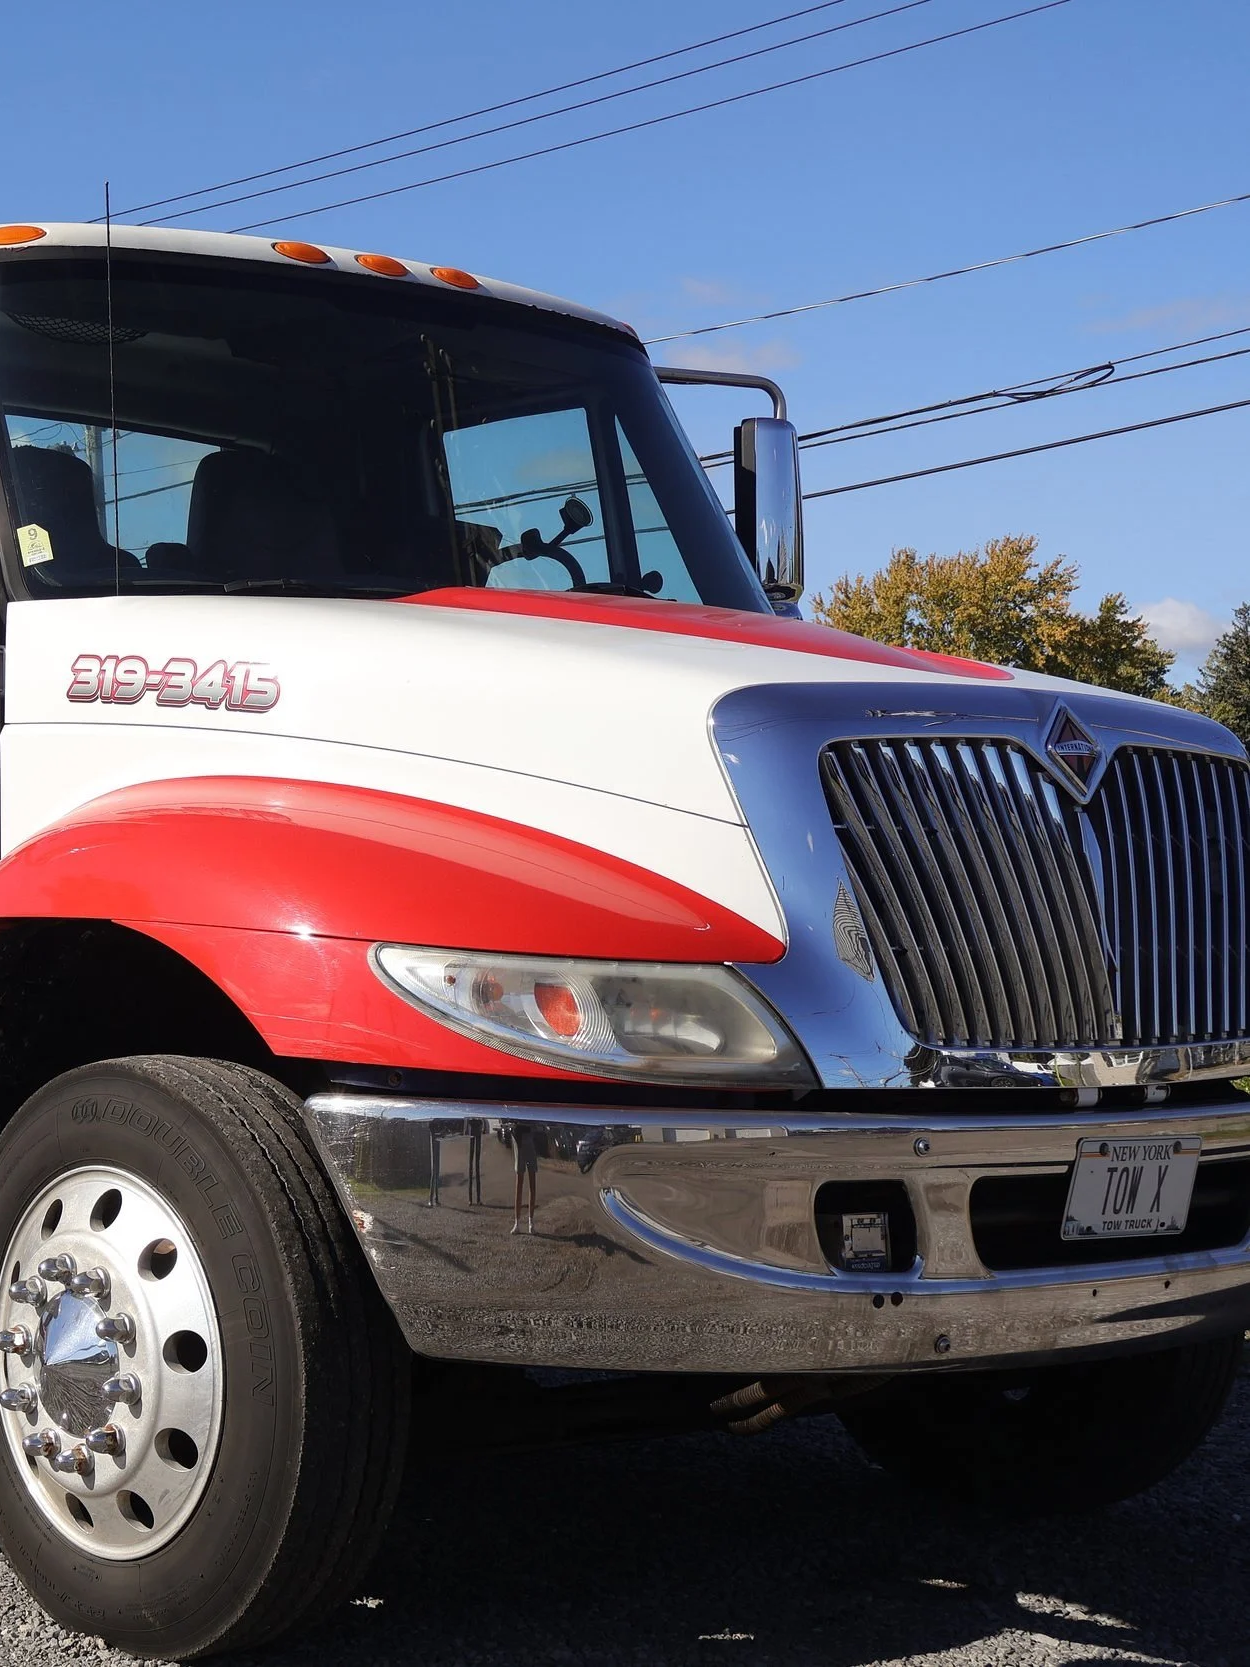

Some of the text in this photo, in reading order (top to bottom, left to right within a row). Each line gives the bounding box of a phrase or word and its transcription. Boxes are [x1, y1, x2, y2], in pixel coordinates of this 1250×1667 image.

[27, 527, 38, 541] 9
[66, 654, 281, 714] 319-3415
[1057, 741, 1095, 752] INTERNATIO
[1111, 1144, 1174, 1162] NEW YORK
[1102, 1165, 1169, 1215] TOW X
[1102, 1219, 1153, 1231] TOW TRUCK
[101, 1099, 243, 1240] DOUBLE
[231, 1253, 275, 1407] COIN
